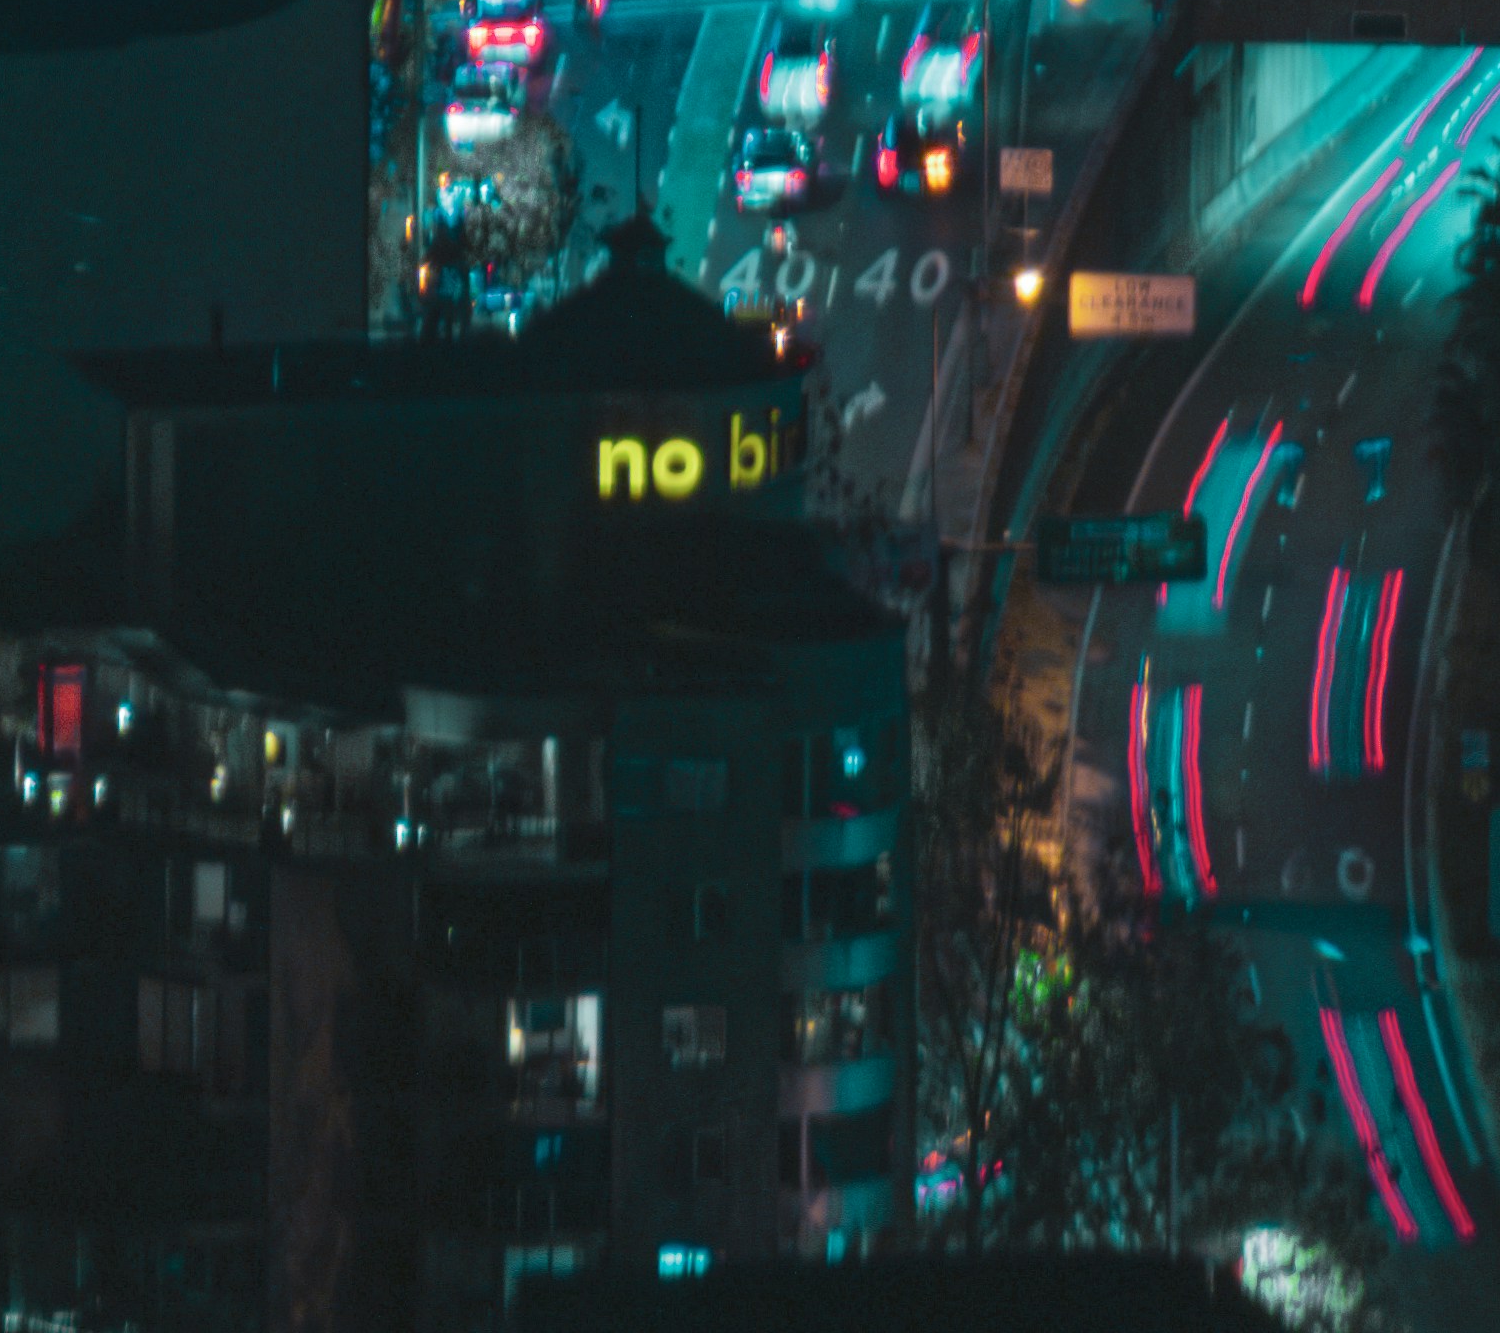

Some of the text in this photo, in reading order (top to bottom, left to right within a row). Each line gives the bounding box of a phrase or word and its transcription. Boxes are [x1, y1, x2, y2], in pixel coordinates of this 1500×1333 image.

[719, 247, 816, 299] 40
[854, 247, 949, 307] 40
[597, 436, 704, 502] no
